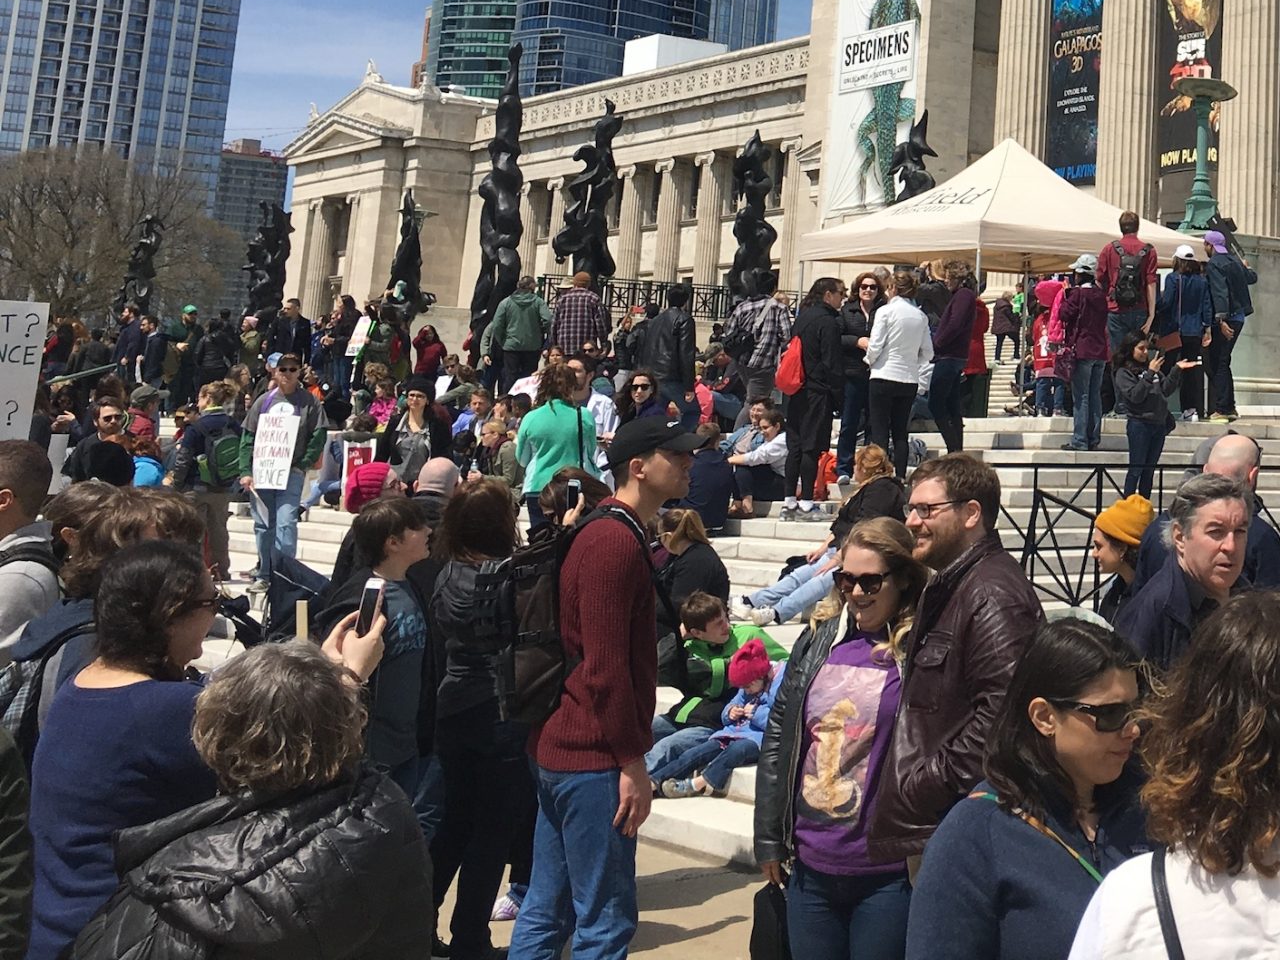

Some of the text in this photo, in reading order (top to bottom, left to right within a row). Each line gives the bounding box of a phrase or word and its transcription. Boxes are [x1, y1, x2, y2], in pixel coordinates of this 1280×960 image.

[844, 30, 910, 67] SPECIMENS
[1071, 56, 1084, 73] 3D
[1161, 150, 1181, 167] NOW
[1066, 163, 1097, 180] PLAYIN
[912, 186, 992, 208] Field
[264, 416, 286, 429] MAKE
[268, 445, 291, 459] AGAIN
[259, 459, 276, 469] WITH
